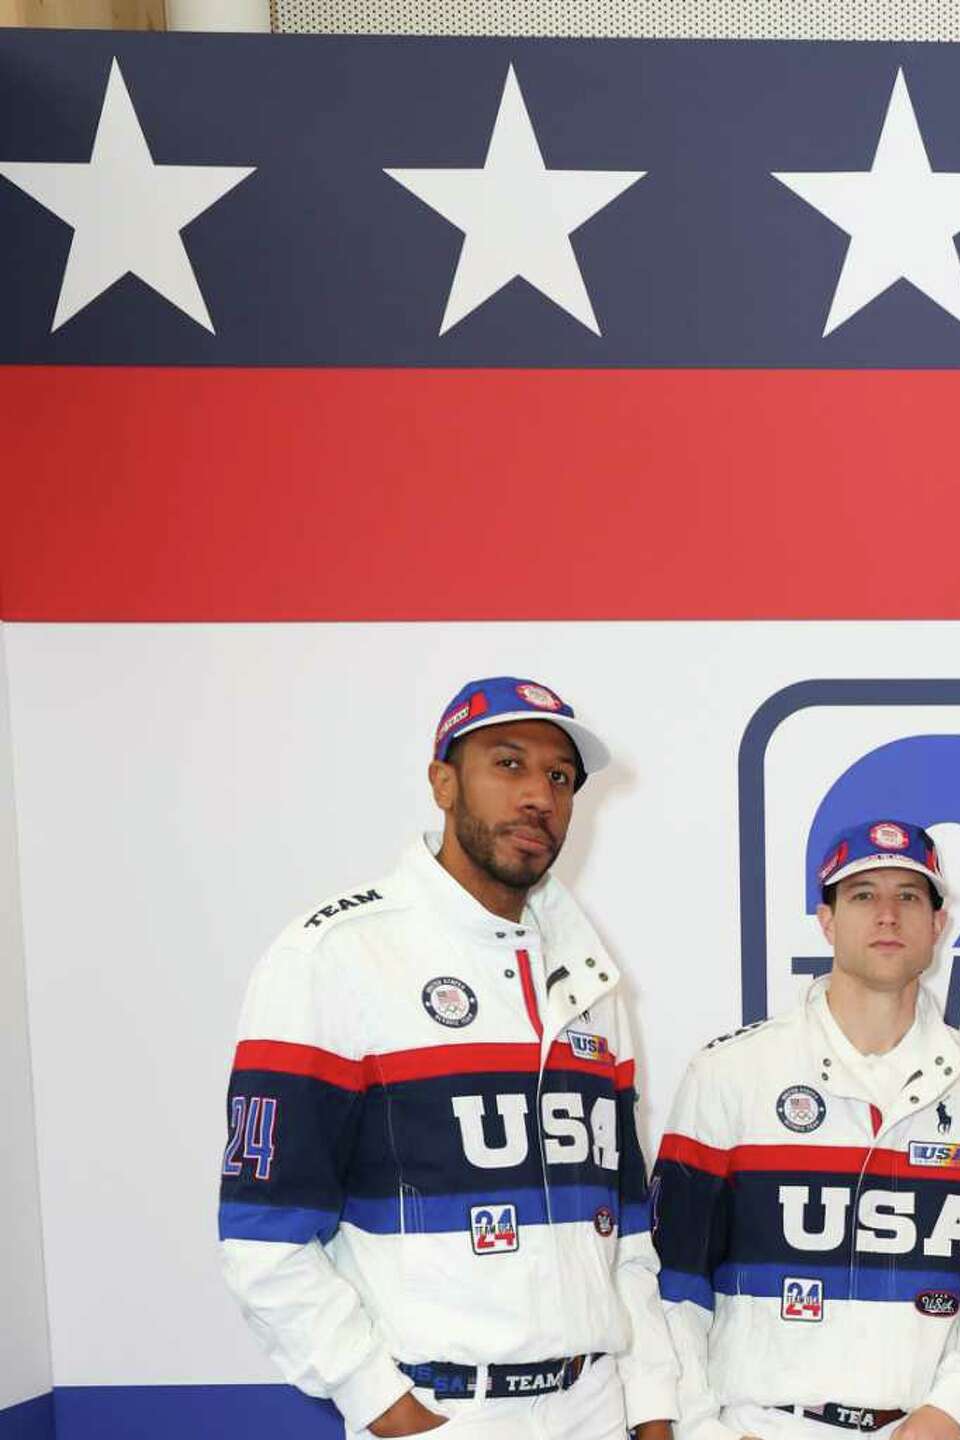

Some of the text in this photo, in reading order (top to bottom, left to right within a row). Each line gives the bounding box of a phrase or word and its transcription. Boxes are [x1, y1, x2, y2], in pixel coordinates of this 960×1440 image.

[303, 889, 384, 928] TEAM
[222, 1096, 277, 1180] 24
[451, 1092, 620, 1171] USA
[474, 1208, 516, 1249] 24
[786, 1281, 821, 1318] 24
[506, 1372, 563, 1391] TEAM
